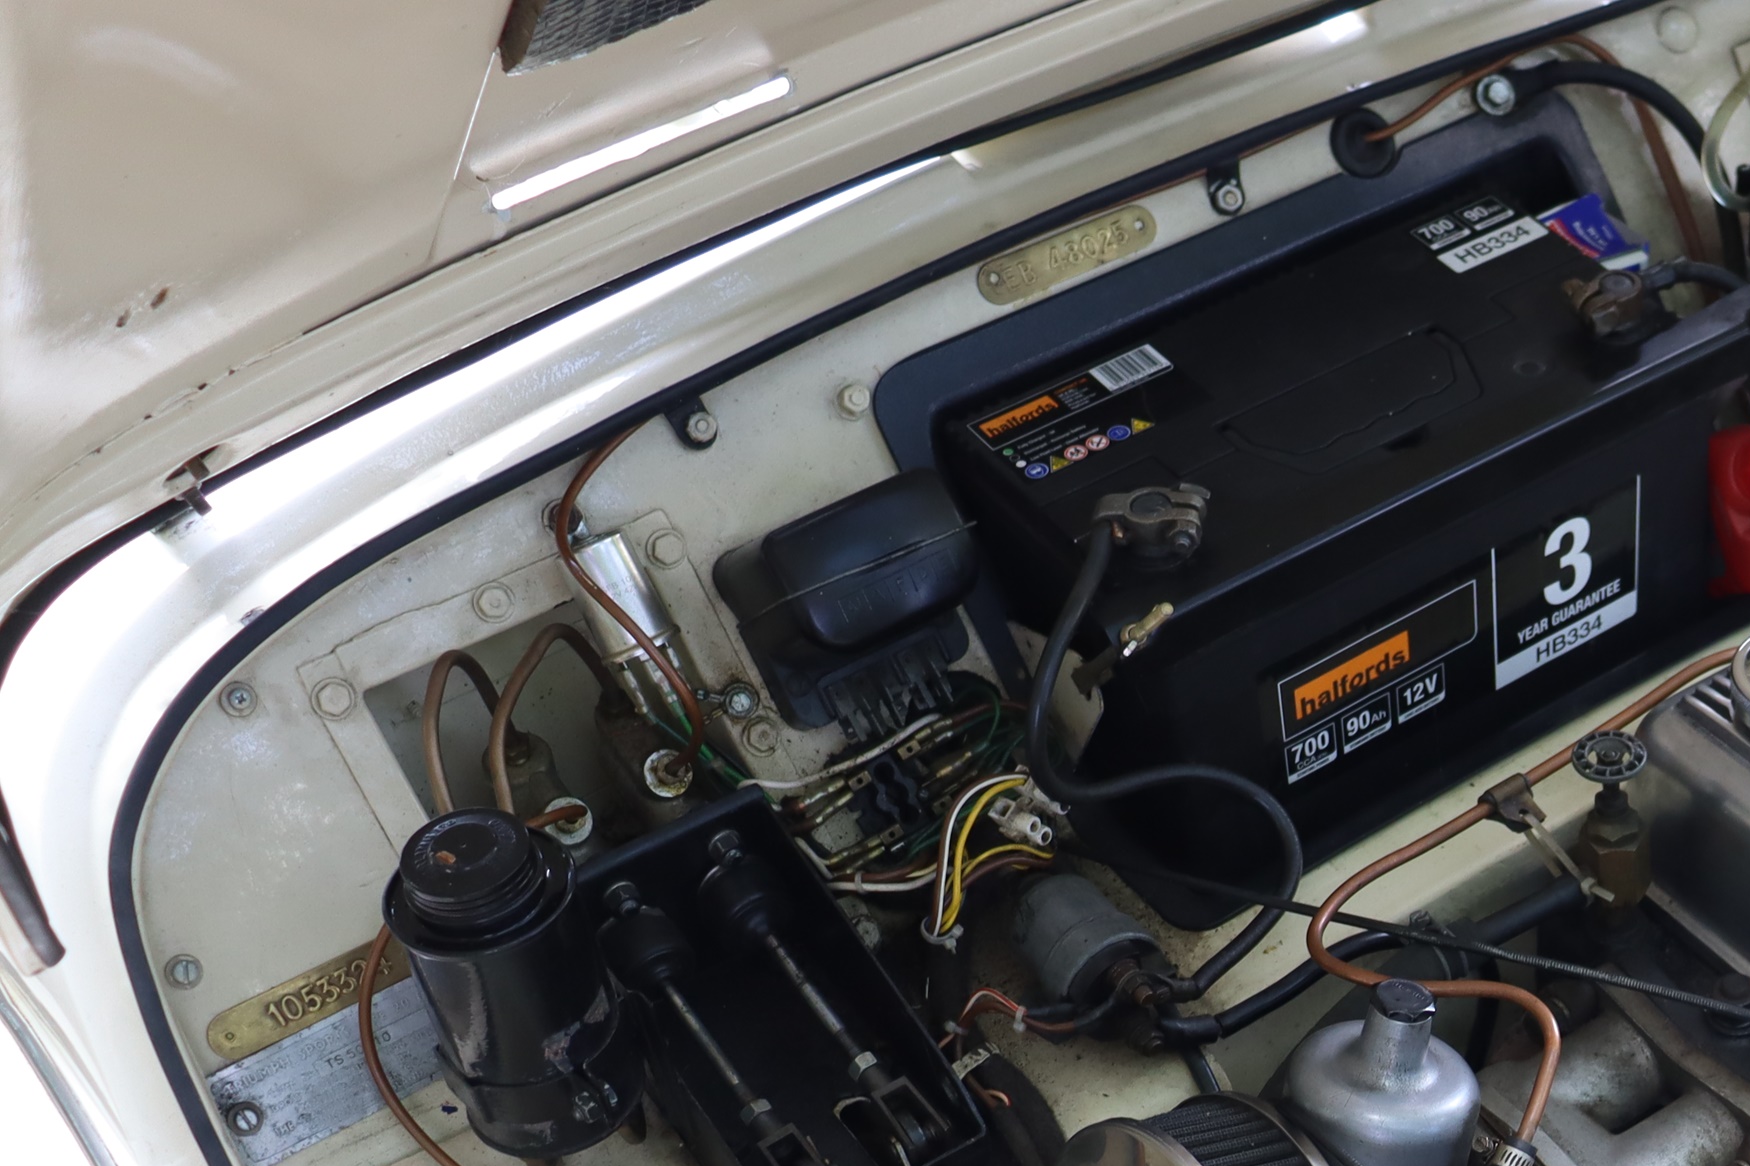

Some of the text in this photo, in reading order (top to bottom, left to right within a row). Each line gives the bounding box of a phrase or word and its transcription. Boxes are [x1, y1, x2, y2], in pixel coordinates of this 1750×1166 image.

[1047, 220, 1129, 271] 48025
[1418, 217, 1455, 242] 700
[1454, 225, 1530, 264] HB334
[986, 400, 1058, 438] halfords
[1543, 516, 1593, 606] 3
[1517, 578, 1621, 645] YEAR GUARANTEE
[1536, 614, 1603, 663] HB334
[1300, 650, 1406, 719] halfords
[1403, 673, 1438, 706] 12V
[1346, 709, 1387, 737] 90Ah
[1291, 729, 1330, 764] 700
[1296, 754, 1317, 770] CCA
[325, 1053, 344, 1069] TS
[348, 1031, 392, 1058] 5010
[224, 1055, 292, 1095] TRIUMPH
